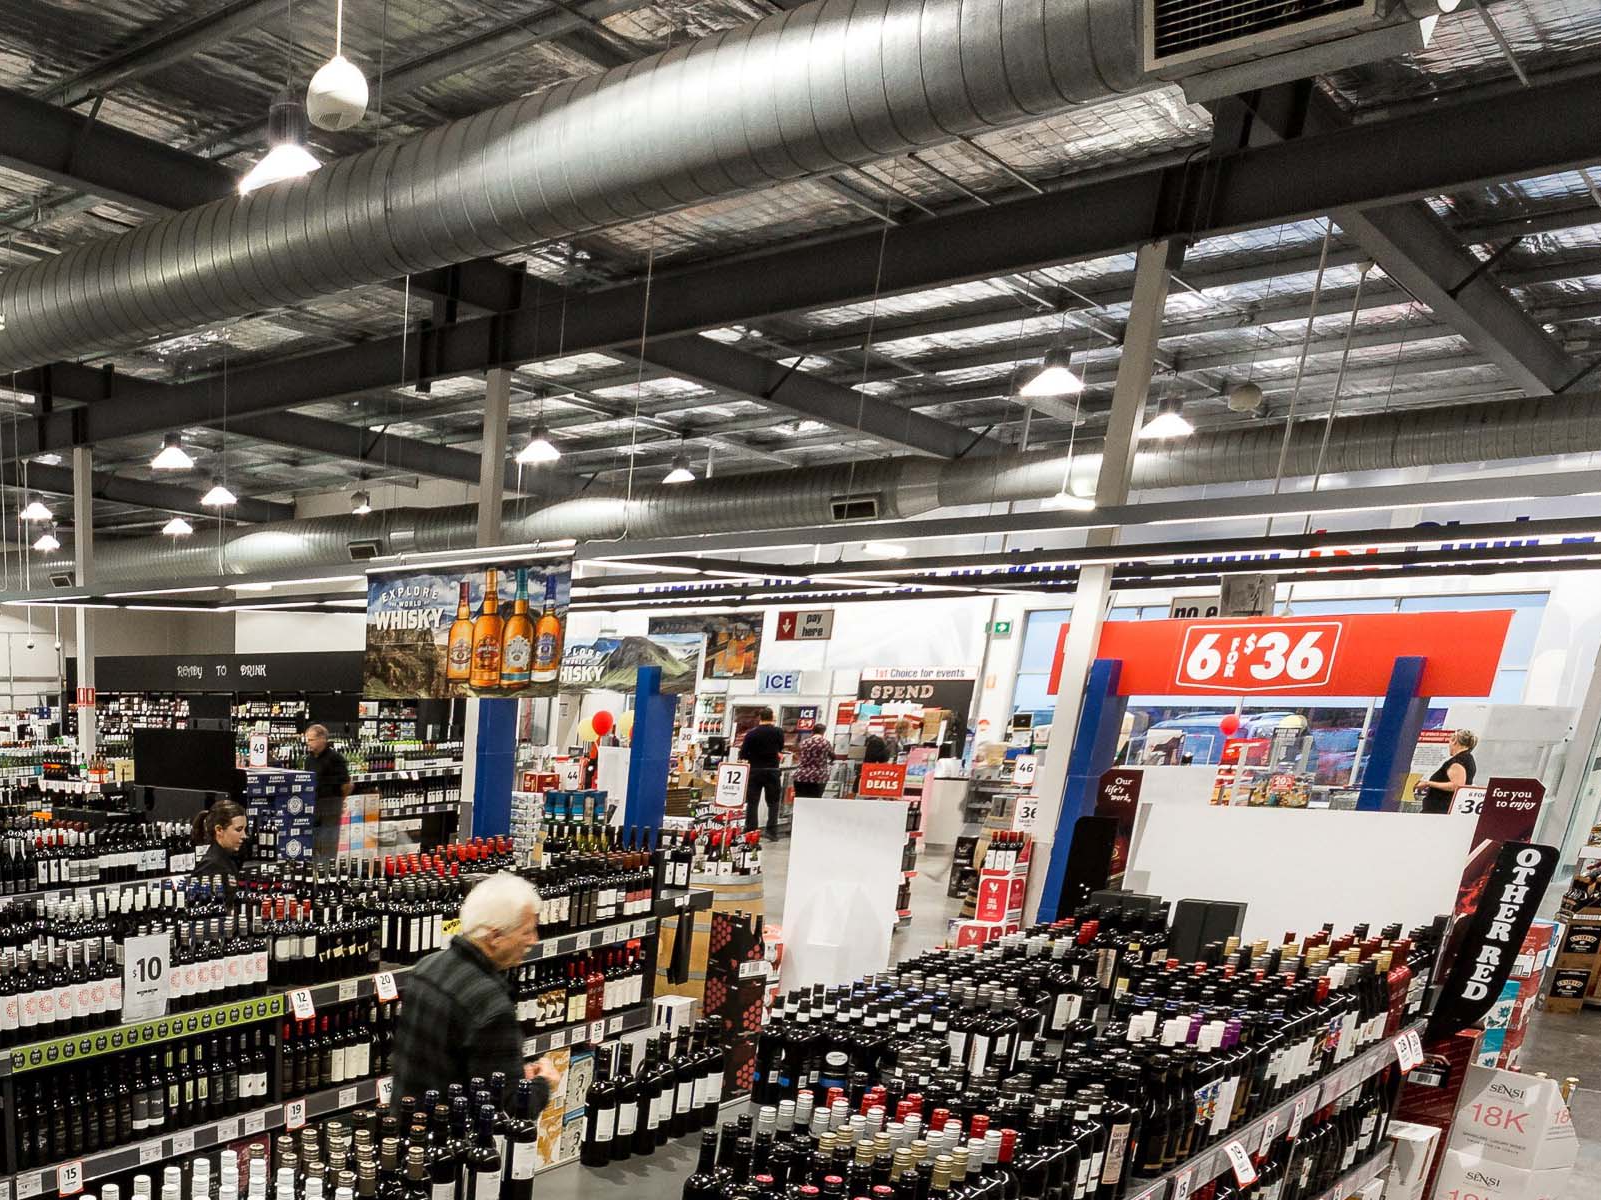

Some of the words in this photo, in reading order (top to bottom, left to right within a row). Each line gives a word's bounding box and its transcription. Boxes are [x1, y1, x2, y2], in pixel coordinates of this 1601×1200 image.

[382, 586, 438, 602] EXPLORE
[399, 600, 422, 609] WORLD
[374, 607, 444, 630] WHISKY
[806, 614, 821, 624] pay
[802, 626, 823, 636] here
[1186, 633, 1221, 680] 6
[1223, 638, 1241, 677] FOR
[1243, 632, 1324, 680] $36
[177, 665, 203, 679] READY
[216, 666, 227, 676] TO
[240, 664, 267, 677] DRINK
[560, 665, 606, 681] HISKY
[890, 669, 918, 678] Choice
[920, 669, 933, 678] for
[936, 669, 965, 678] events
[765, 675, 792, 689] ICE
[870, 685, 934, 699] SPEND
[253, 743, 265, 755] 49
[1019, 763, 1033, 773] 46
[727, 770, 741, 784] 12
[1114, 777, 1133, 785] Our
[866, 779, 898, 790] DEALS
[1105, 784, 1125, 795] life's
[1492, 788, 1510, 798] for
[1511, 791, 1532, 799] you
[1496, 799, 1507, 807] to
[1509, 800, 1536, 811] enjoy
[1486, 848, 1541, 942] OTHER
[132, 956, 162, 983] $10
[1461, 945, 1502, 1001] RED
[1489, 1083, 1525, 1099] SENSI
[1471, 1103, 1530, 1134] 18K
[1466, 1171, 1501, 1188] SENSI
